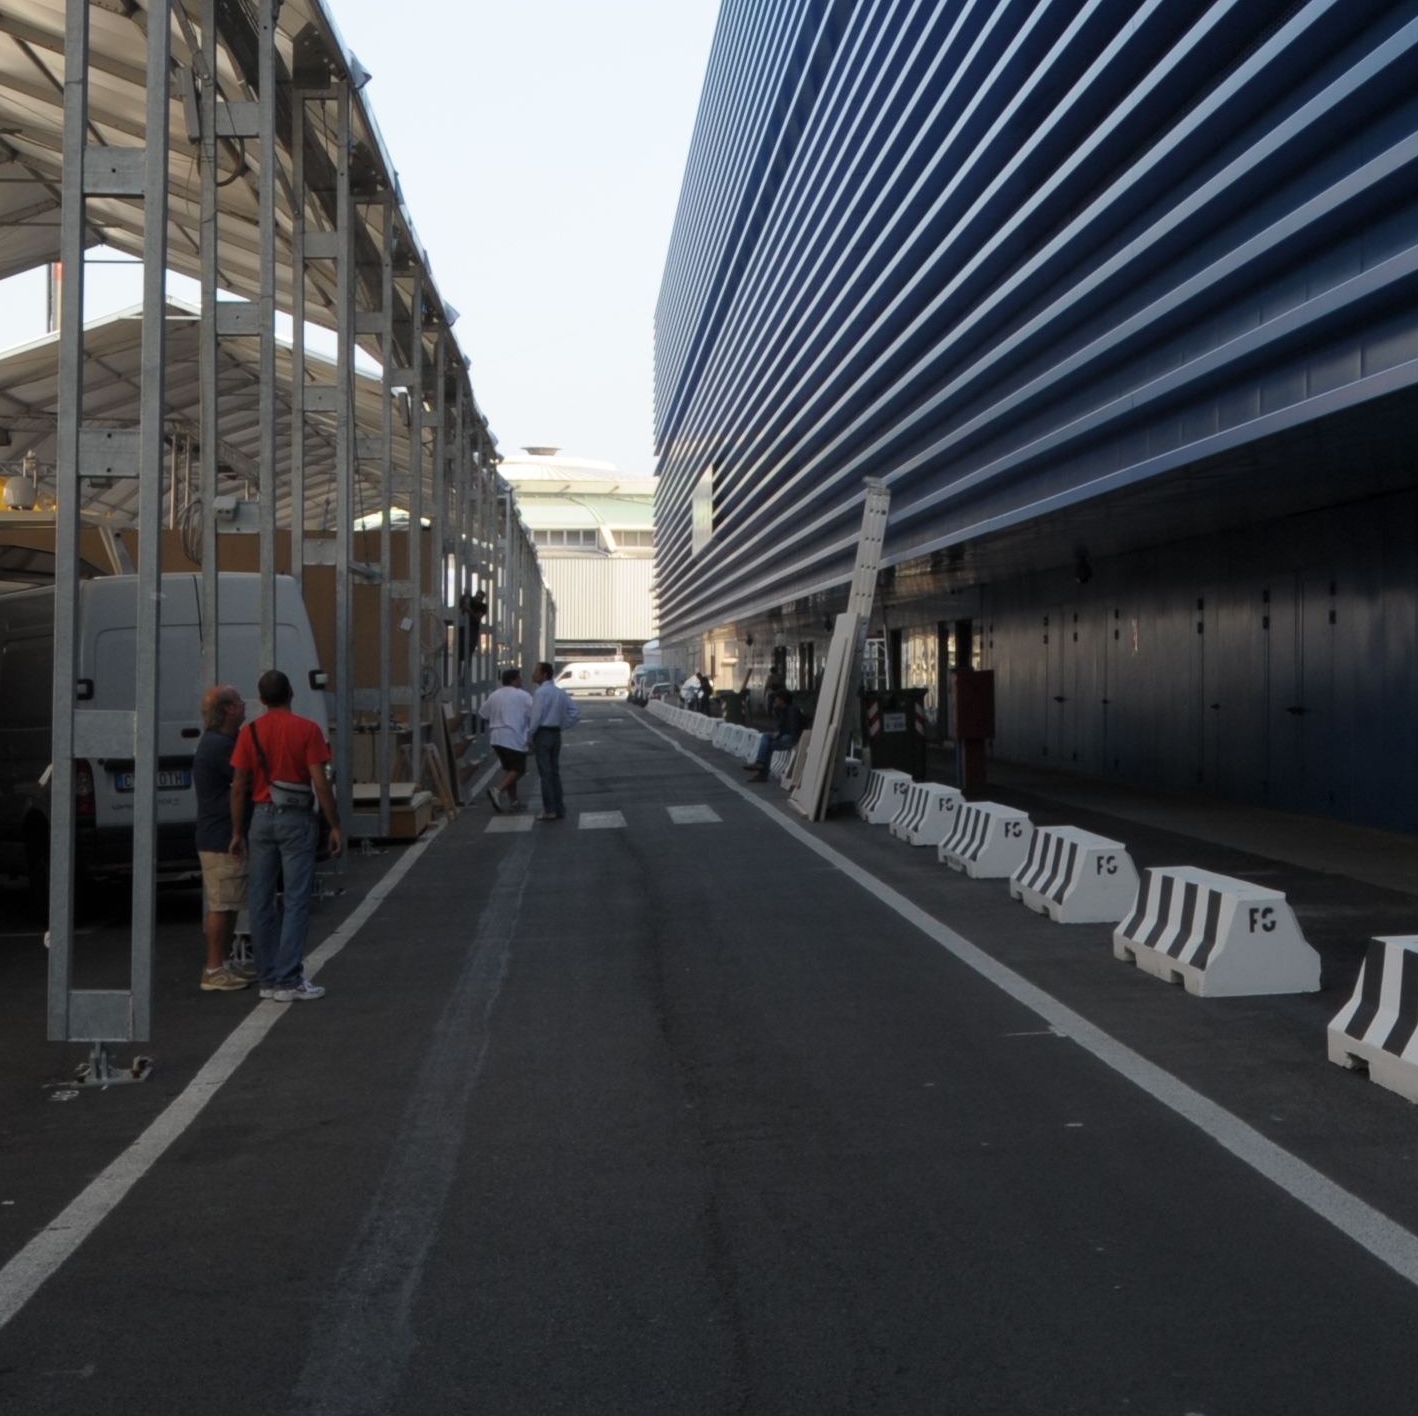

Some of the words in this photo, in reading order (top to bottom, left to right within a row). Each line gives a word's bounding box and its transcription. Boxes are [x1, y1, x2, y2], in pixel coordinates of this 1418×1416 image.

[893, 782, 907, 795] FG
[939, 797, 954, 812] FG
[1004, 821, 1023, 838] FG
[1096, 855, 1118, 876] FG
[1249, 907, 1277, 933] FG
